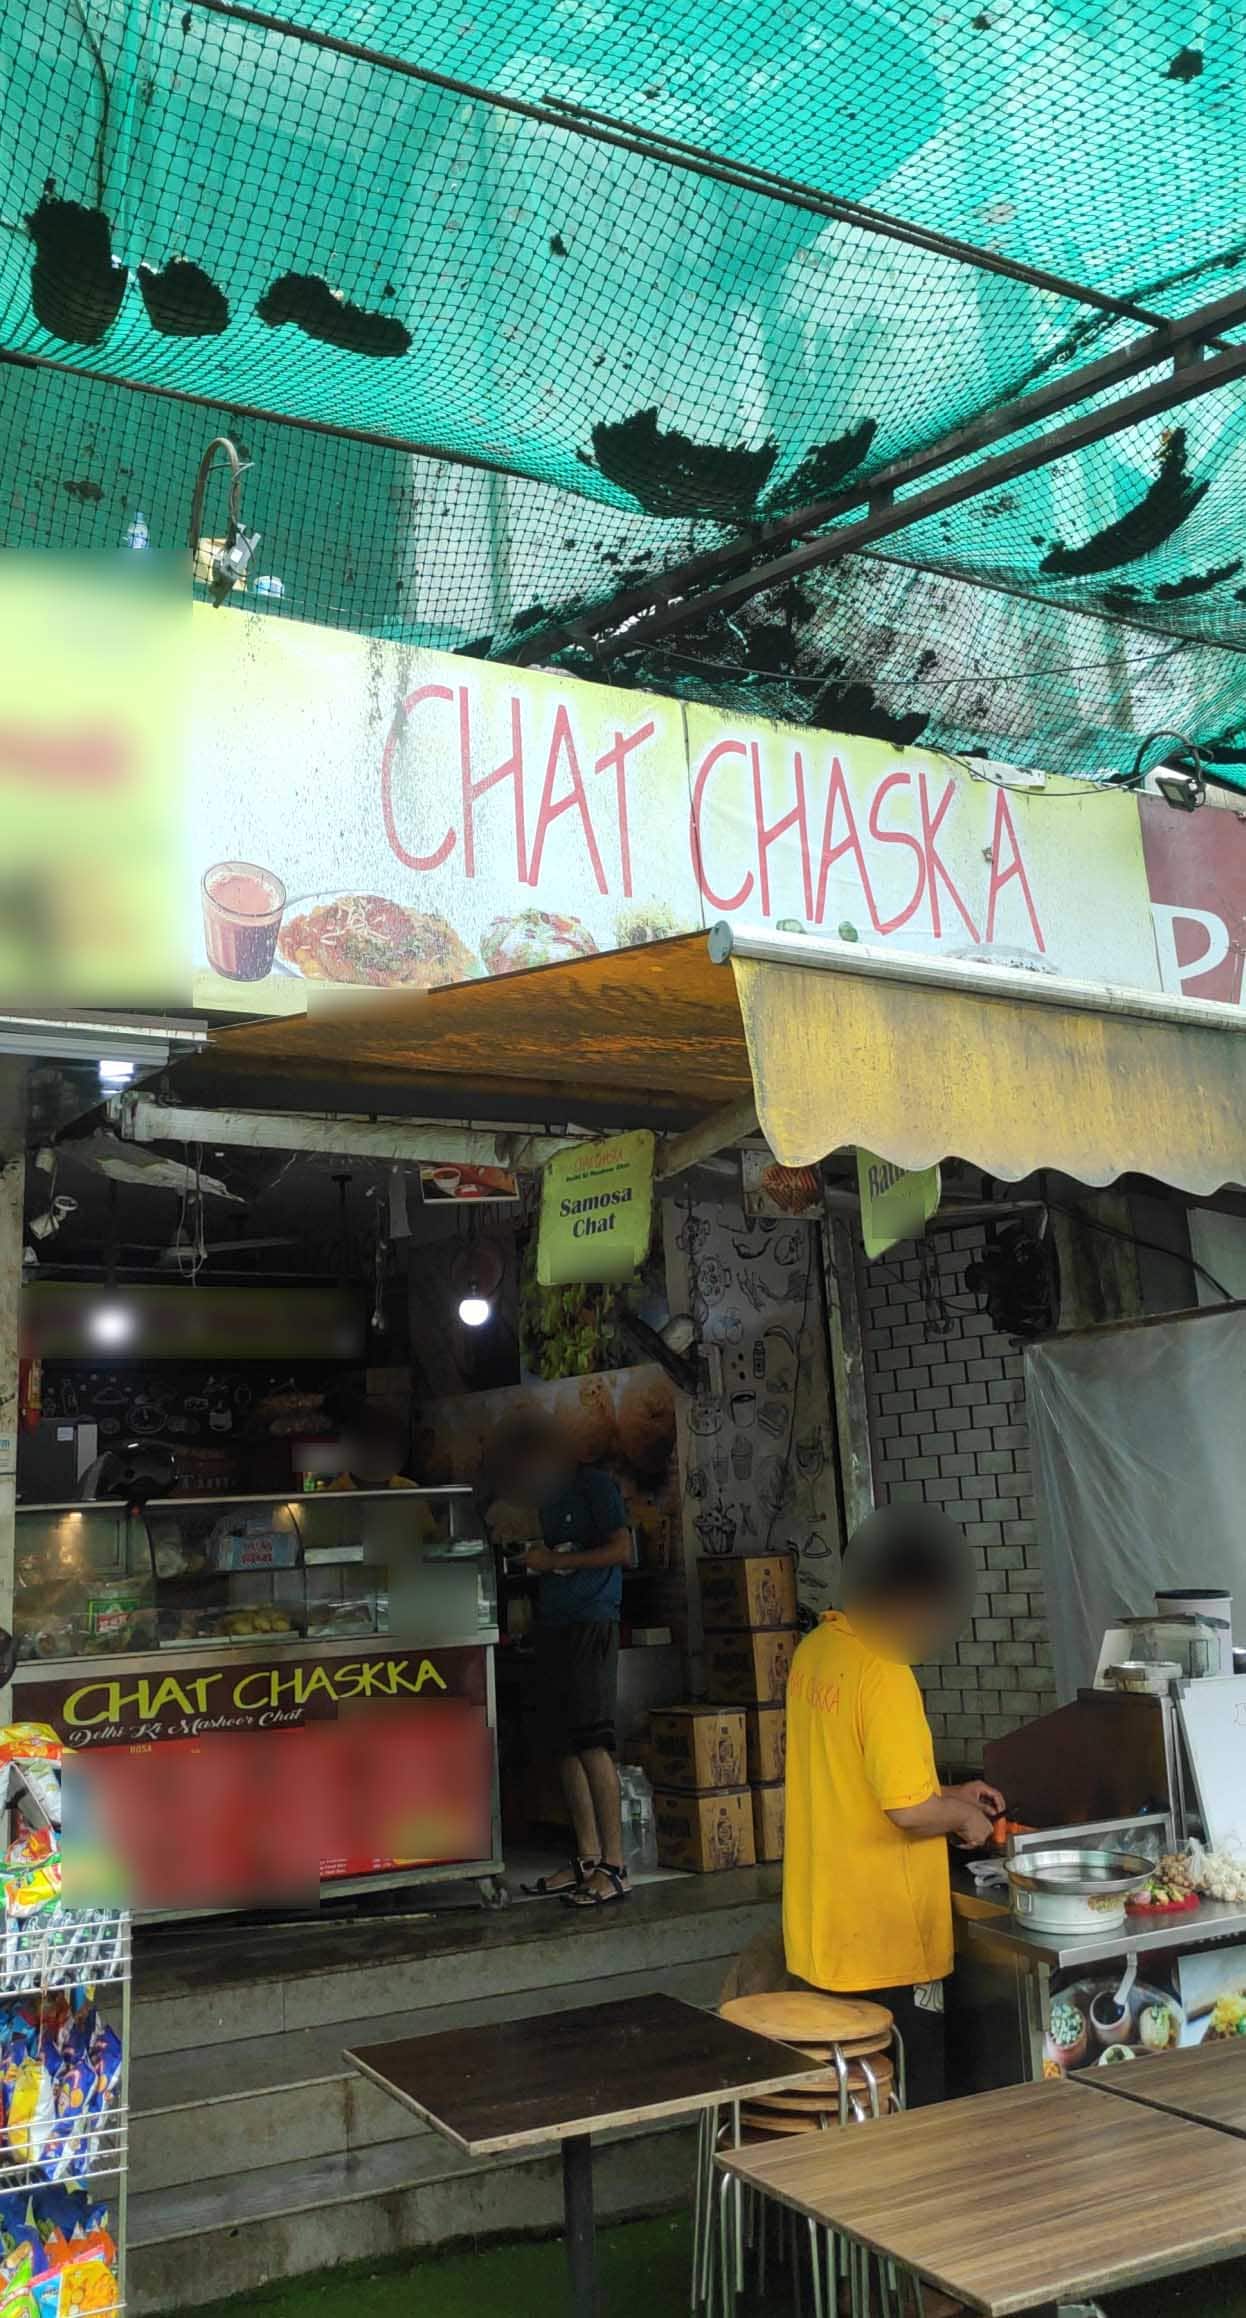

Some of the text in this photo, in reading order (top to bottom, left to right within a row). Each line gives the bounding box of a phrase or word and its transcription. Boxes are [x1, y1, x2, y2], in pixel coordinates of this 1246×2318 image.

[381, 685, 1046, 953] CHAT CHASKA
[1150, 902, 1246, 1007] P
[559, 1187, 633, 1218] Samosa
[572, 1212, 616, 1239] Chat
[63, 1659, 448, 1726] CHAT CHASKKA
[68, 1708, 304, 1747] Delhi Ki Mashoor Chat
